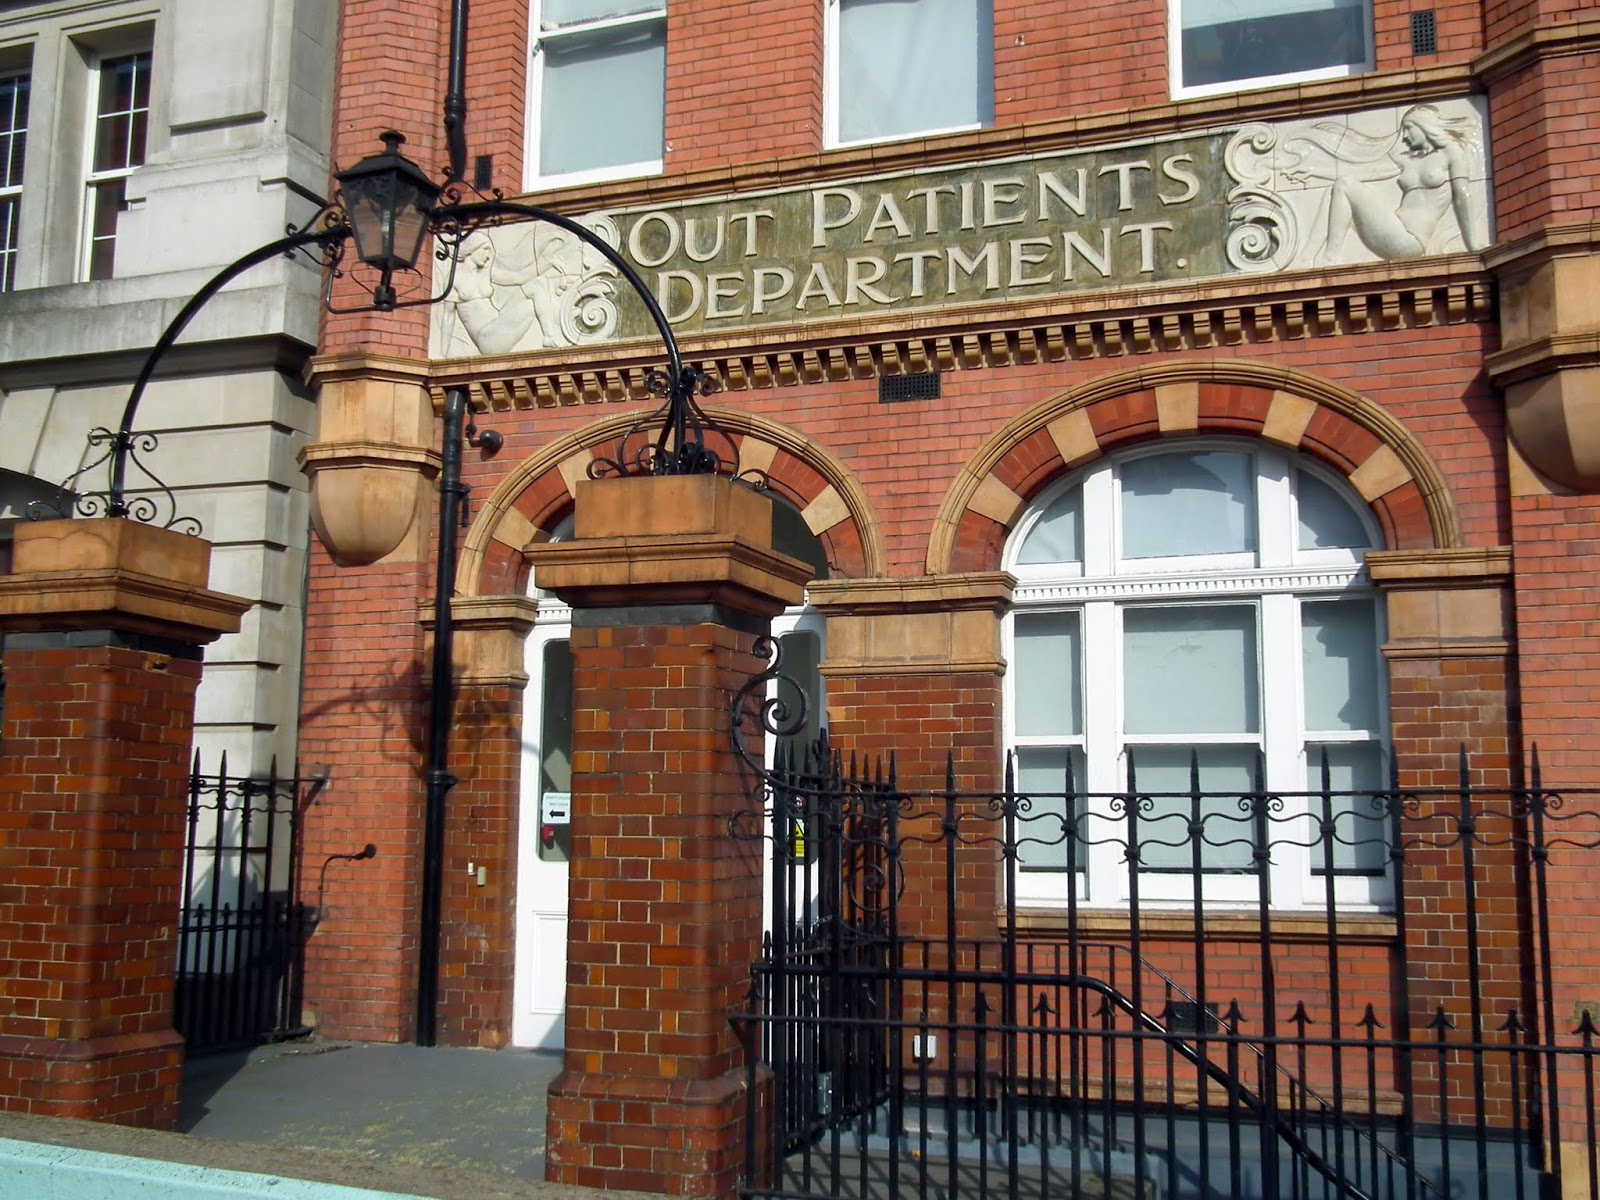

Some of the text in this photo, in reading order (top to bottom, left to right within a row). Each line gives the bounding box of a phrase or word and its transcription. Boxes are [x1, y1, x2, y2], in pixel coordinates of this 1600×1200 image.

[628, 154, 1201, 267] OUT PATIENTS
[656, 221, 1188, 324] DEPARTMENT.
